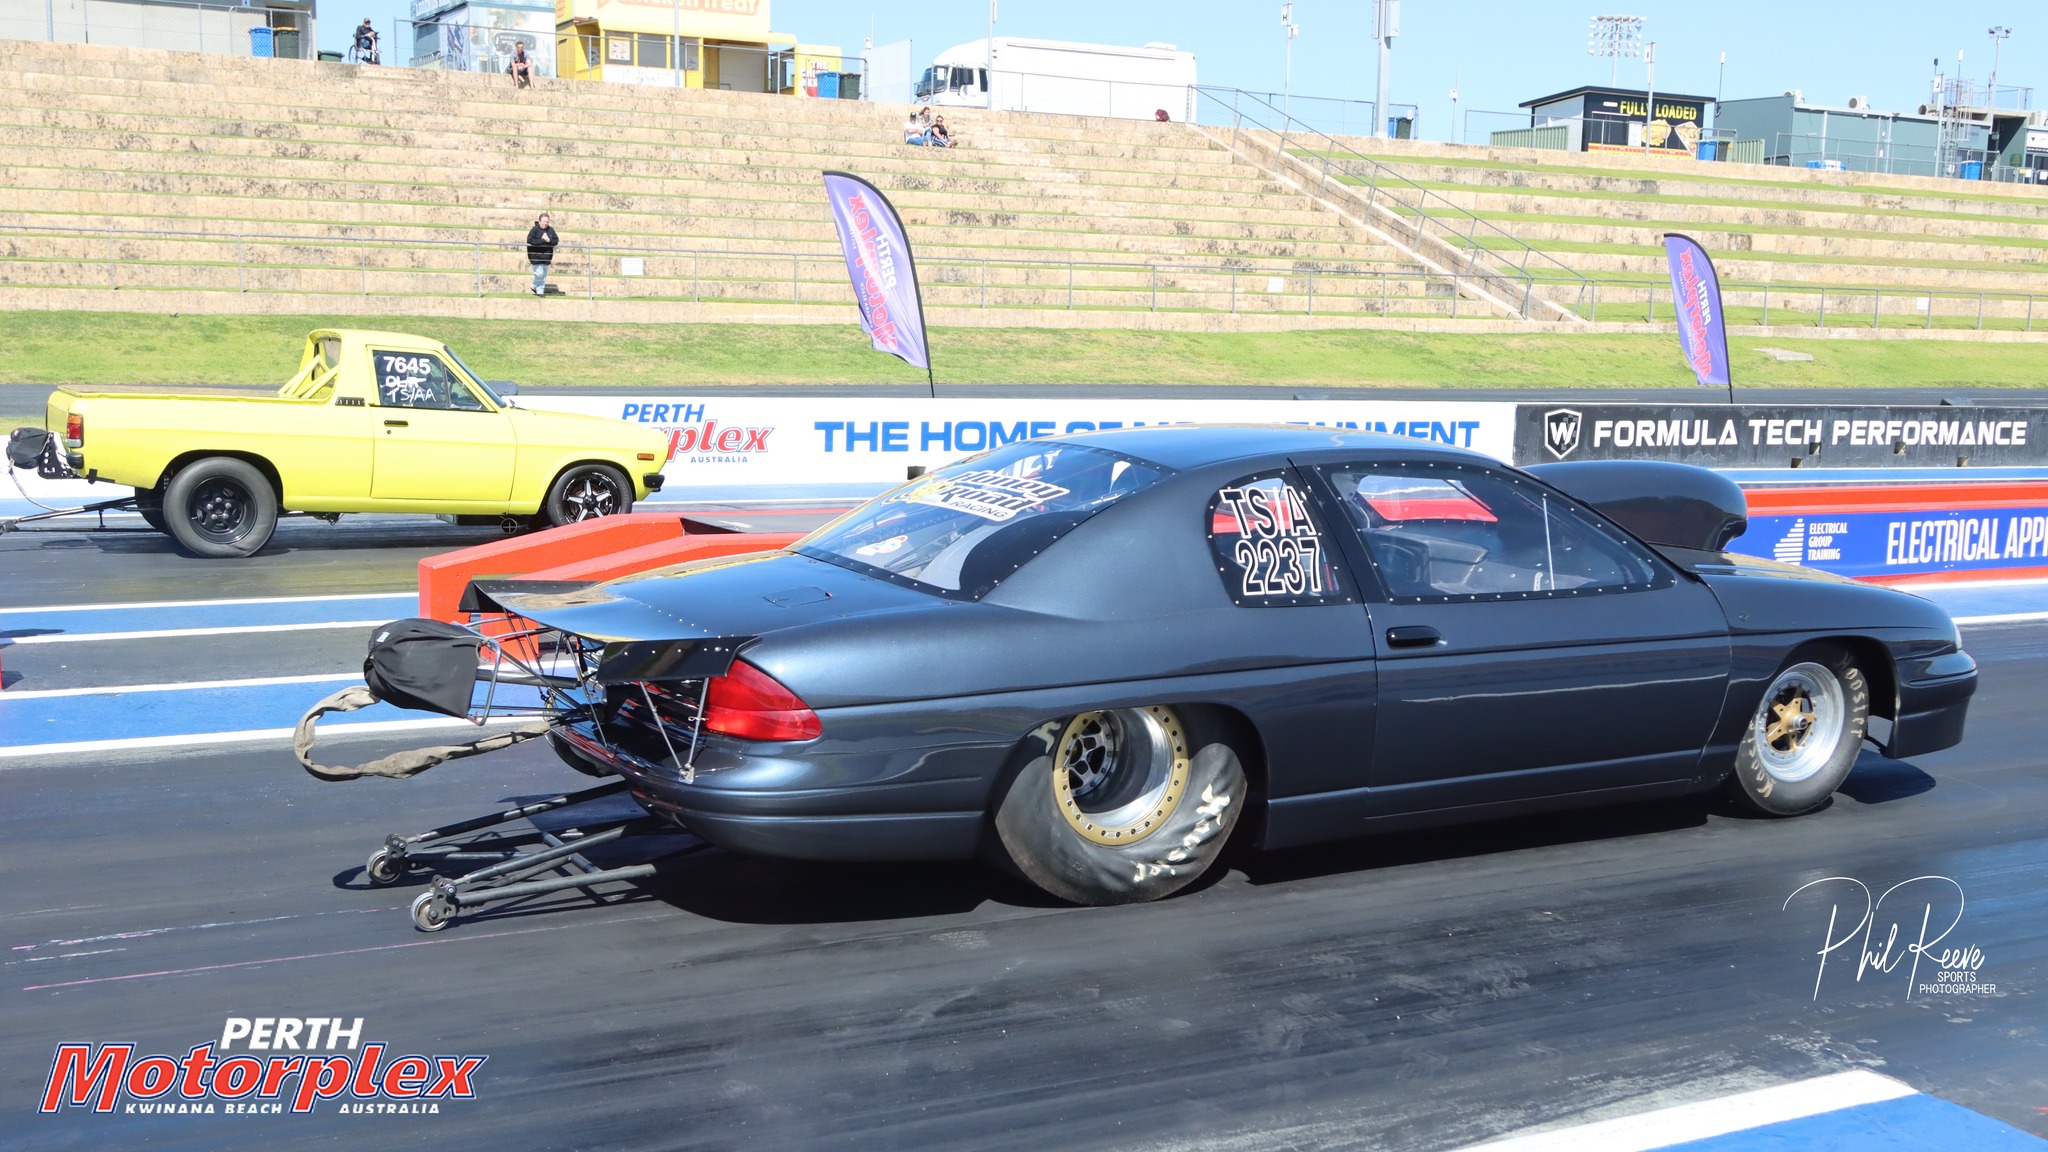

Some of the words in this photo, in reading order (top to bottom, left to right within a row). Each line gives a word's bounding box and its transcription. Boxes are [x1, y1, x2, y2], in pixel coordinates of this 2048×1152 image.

[1656, 104, 1697, 120] LOADED
[383, 356, 430, 375] 7645
[622, 403, 705, 423] PERTH
[814, 421, 909, 452] THE
[1594, 419, 1738, 447] FORMULA
[1749, 419, 1822, 446] TECH
[1832, 420, 2027, 446] PERFORMANCE
[951, 501, 1008, 518] RACING
[1809, 522, 1848, 535] ELECTRICAL
[1808, 536, 1833, 548] GROUP
[1886, 518, 2000, 565] ELECTRICAL
[1807, 548, 1840, 561] TRAINING
[1235, 536, 1322, 596] 2237
